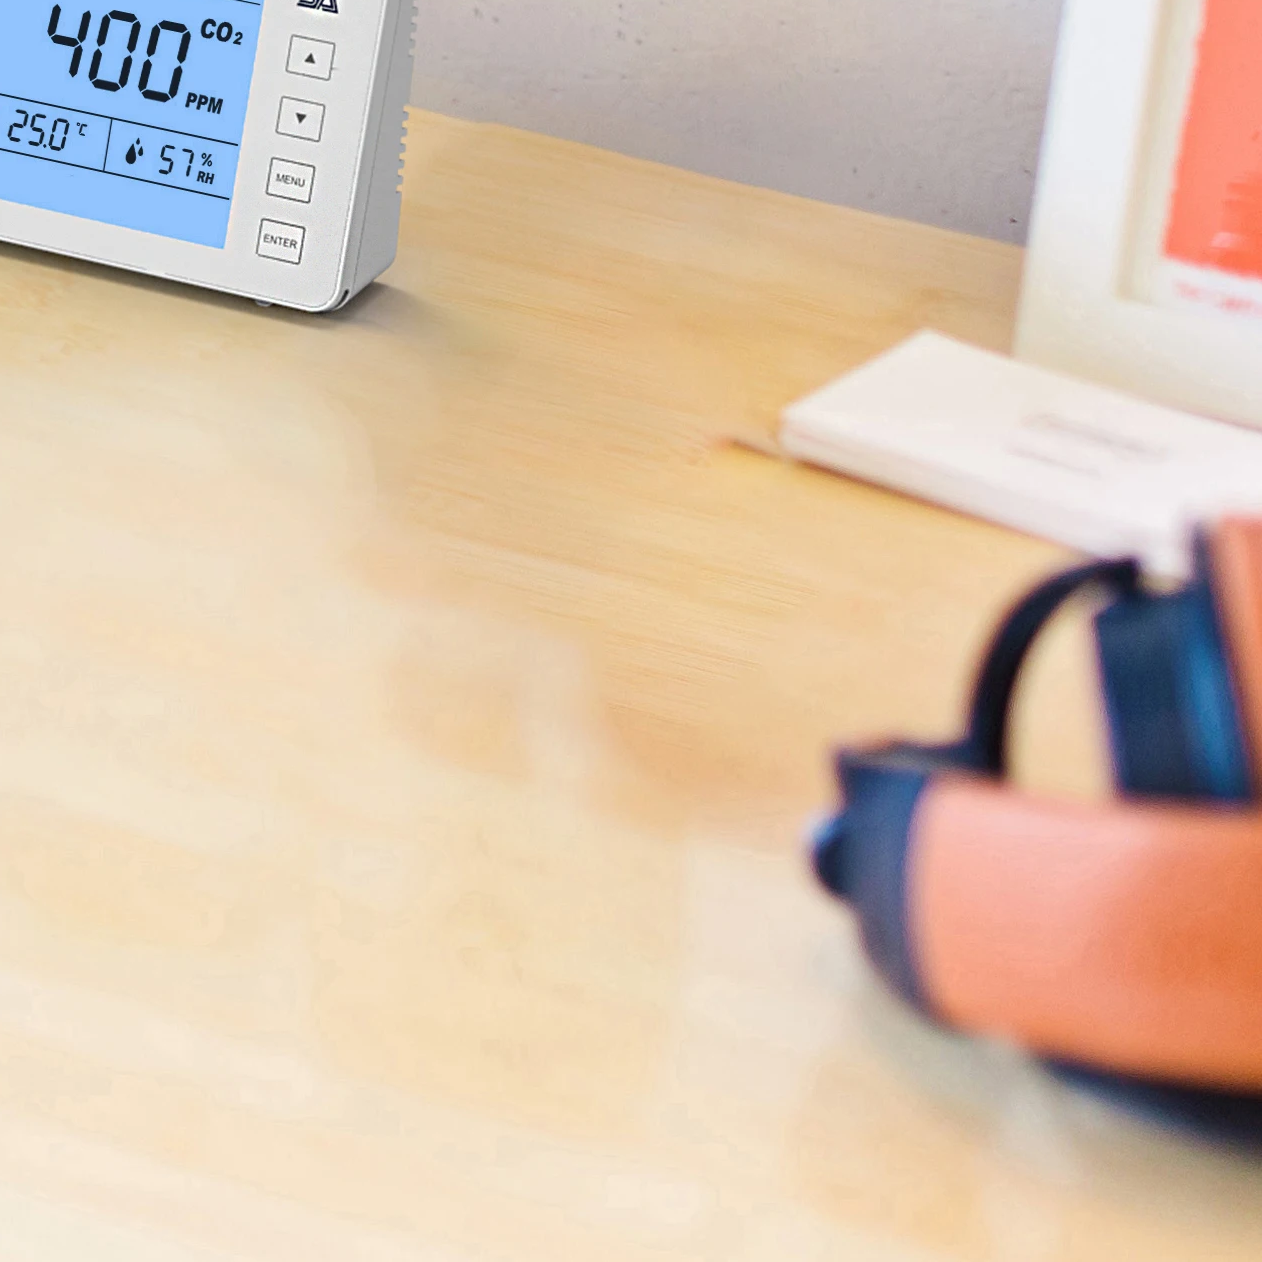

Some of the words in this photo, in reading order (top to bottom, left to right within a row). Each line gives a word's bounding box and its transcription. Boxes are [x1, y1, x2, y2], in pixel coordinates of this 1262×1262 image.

[47, 3, 191, 103] 400
[184, 92, 224, 115] PPM
[7, 109, 70, 152] 25.0
[158, 144, 195, 177] 57
[196, 170, 215, 185] RH
[275, 172, 306, 188] MENU
[263, 232, 298, 250] ENTER
